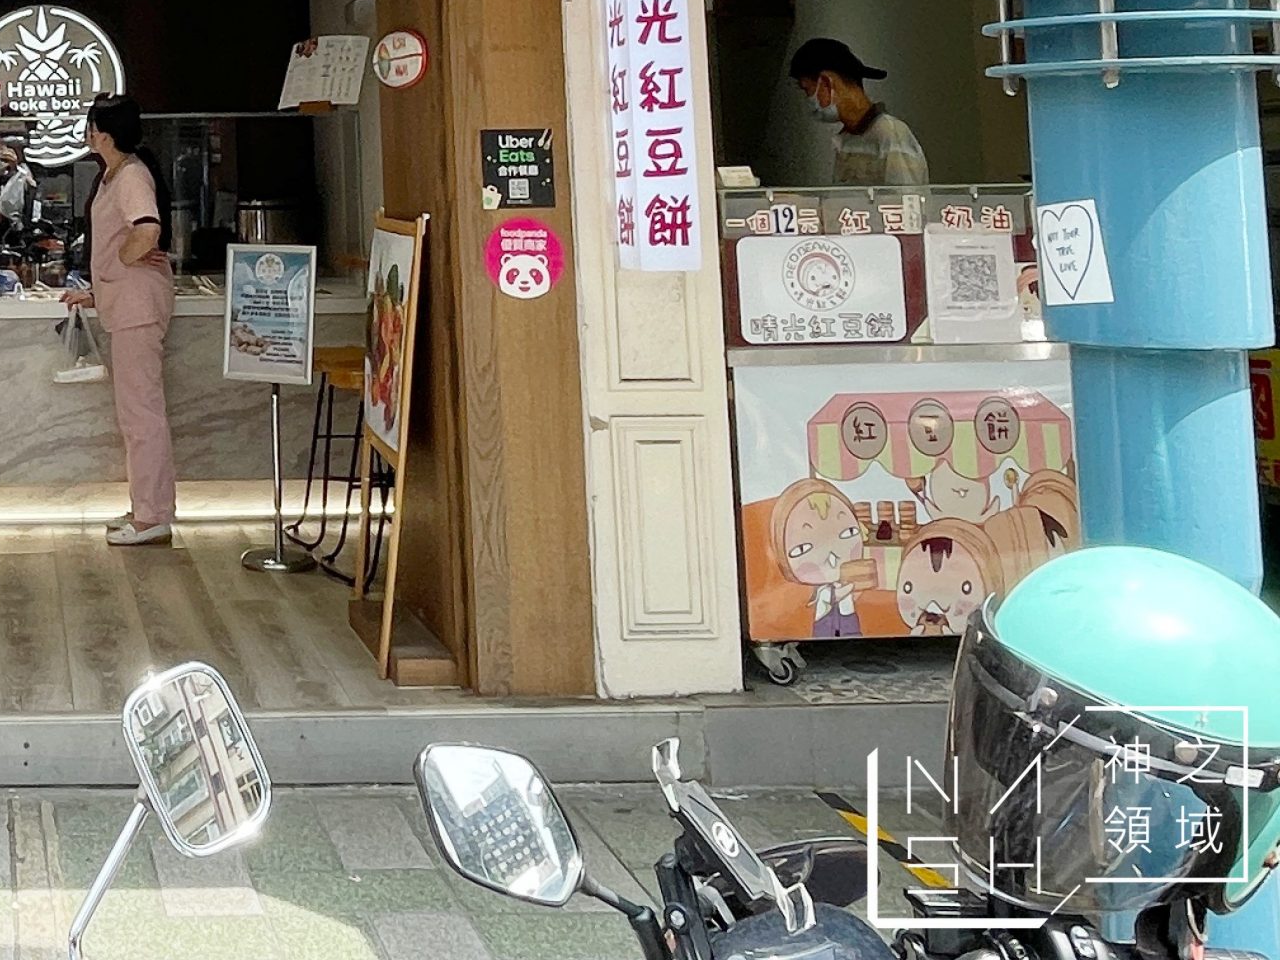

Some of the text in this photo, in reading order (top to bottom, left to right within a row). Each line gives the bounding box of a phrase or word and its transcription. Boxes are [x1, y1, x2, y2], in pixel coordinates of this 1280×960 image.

[7, 78, 82, 98] Hawaii
[51, 96, 80, 111] box
[498, 134, 535, 149] Uber
[499, 149, 535, 163] Eats
[725, 204, 820, 235] 一個12元
[838, 204, 906, 235] 紅豆
[941, 204, 1013, 232] 奶油
[750, 312, 896, 342] 晴光紅豆餅
